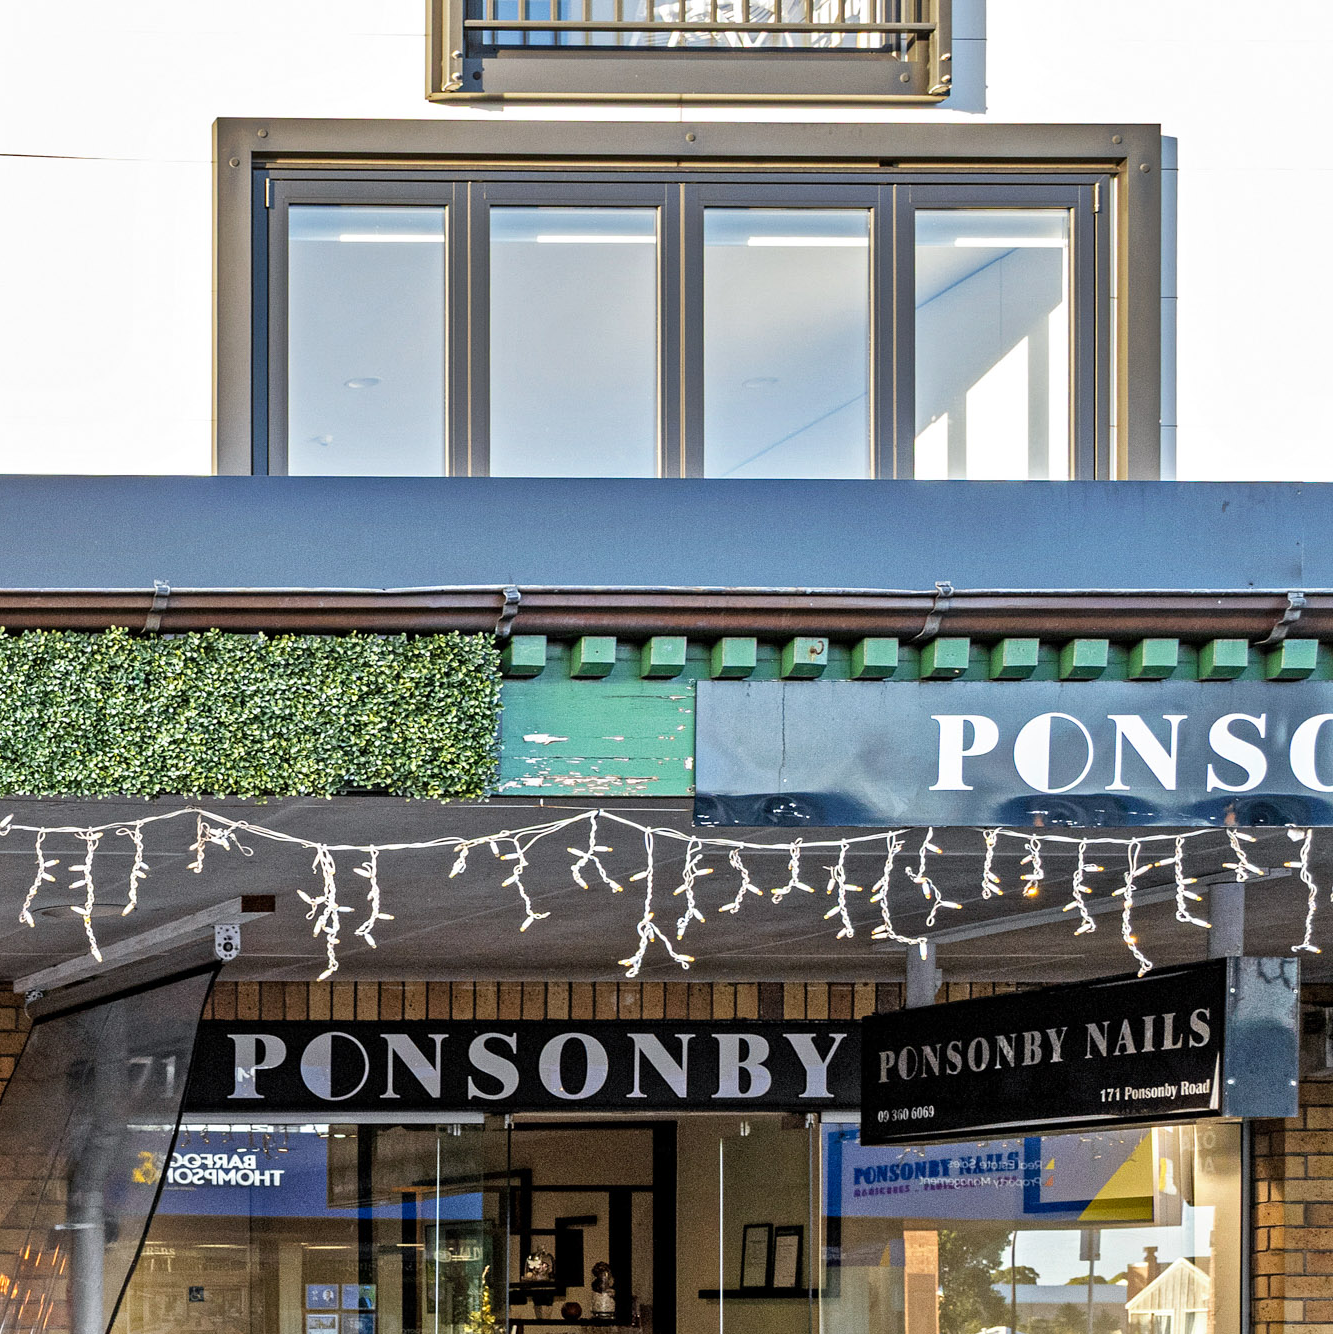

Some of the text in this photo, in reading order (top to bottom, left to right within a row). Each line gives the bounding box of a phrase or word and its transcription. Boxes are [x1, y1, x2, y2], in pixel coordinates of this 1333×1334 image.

[227, 1031, 848, 1100] PONSONBY
[878, 1008, 1211, 1083] PONSONBY NAILS
[1100, 1079, 1211, 1102] 171 Ponsonby Road
[878, 1110, 889, 1124] 09
